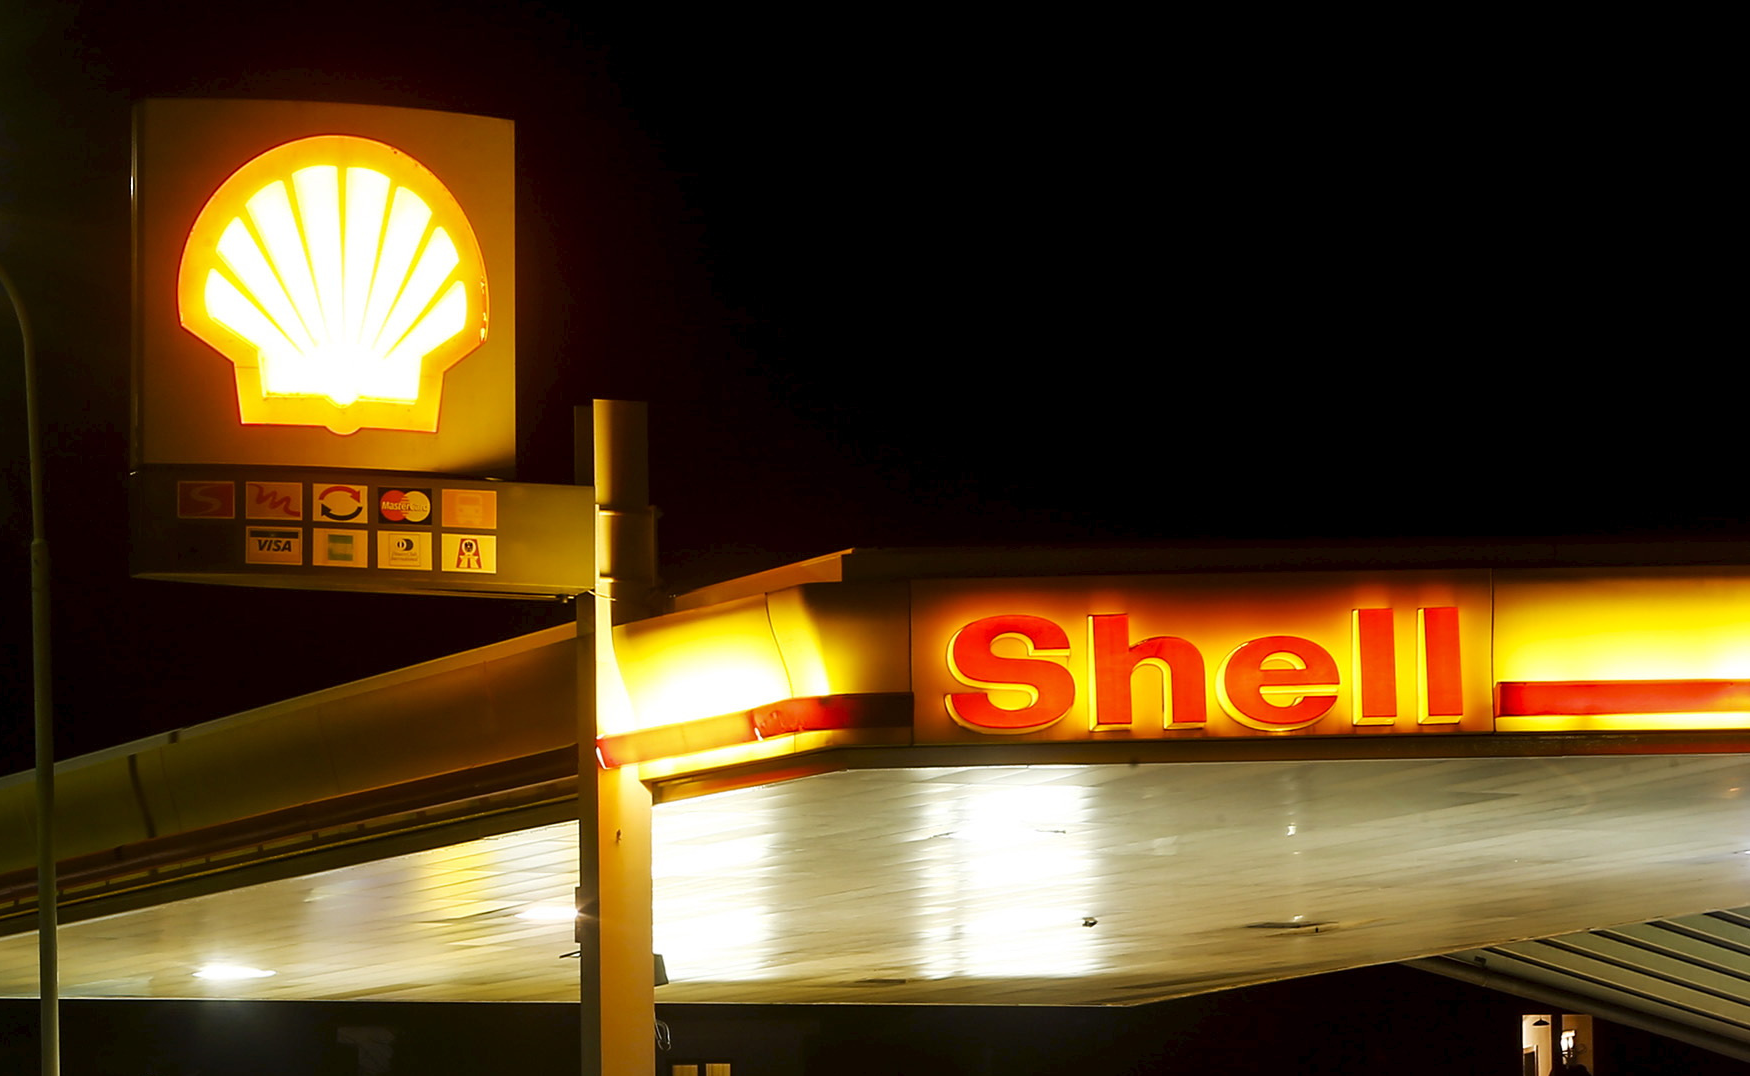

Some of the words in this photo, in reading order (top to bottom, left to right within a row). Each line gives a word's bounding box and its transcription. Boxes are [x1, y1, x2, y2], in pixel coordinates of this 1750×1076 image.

[380, 499, 429, 513] MasterCard
[256, 539, 292, 553] VISA
[943, 606, 1464, 734] Shell
